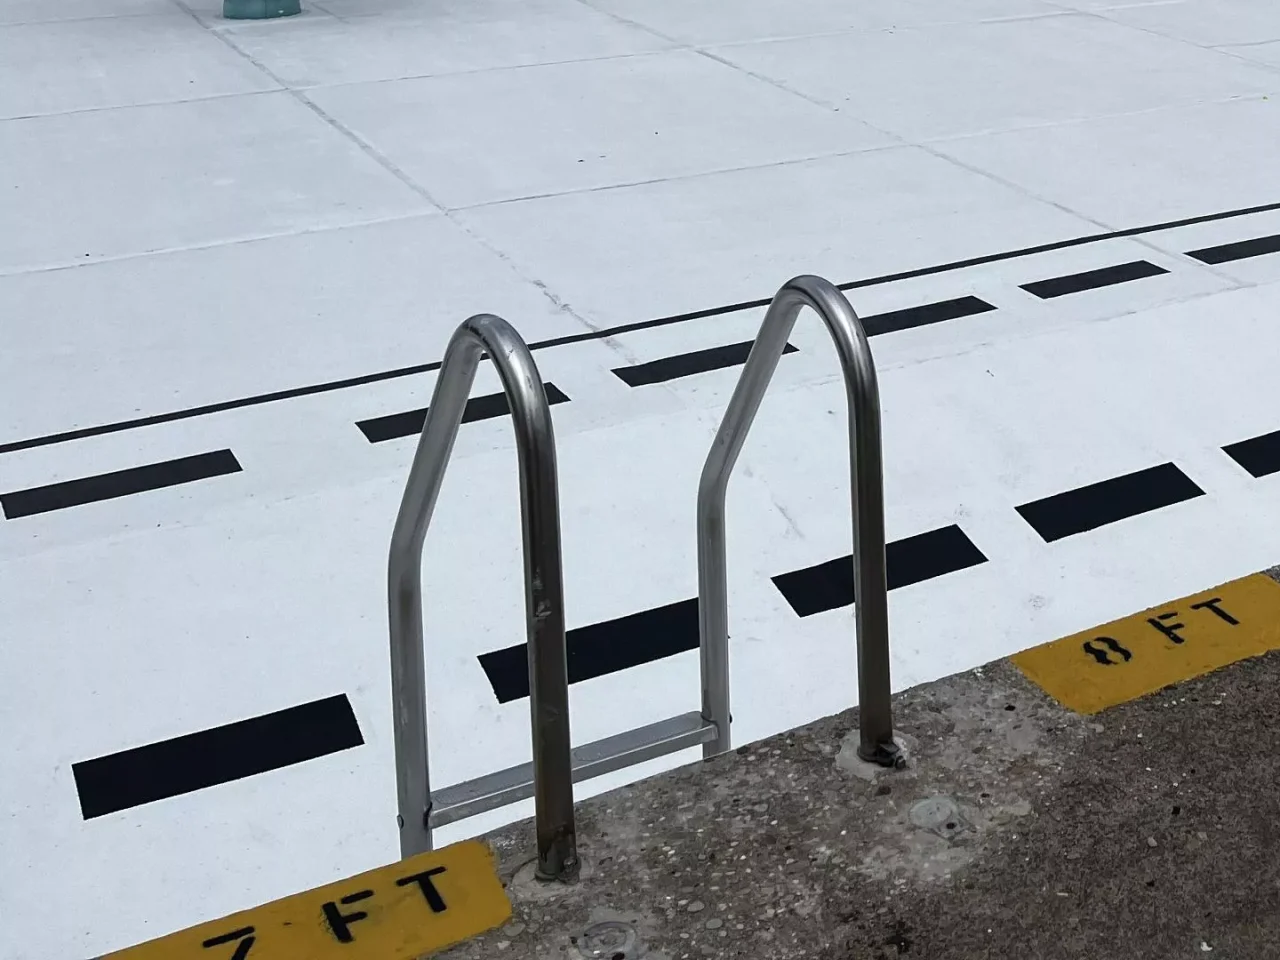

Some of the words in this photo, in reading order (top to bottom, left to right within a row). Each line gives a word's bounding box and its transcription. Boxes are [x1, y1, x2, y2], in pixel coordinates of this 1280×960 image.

[1146, 597, 1240, 644] FT
[202, 925, 256, 960] 7
[321, 865, 448, 944] FT
